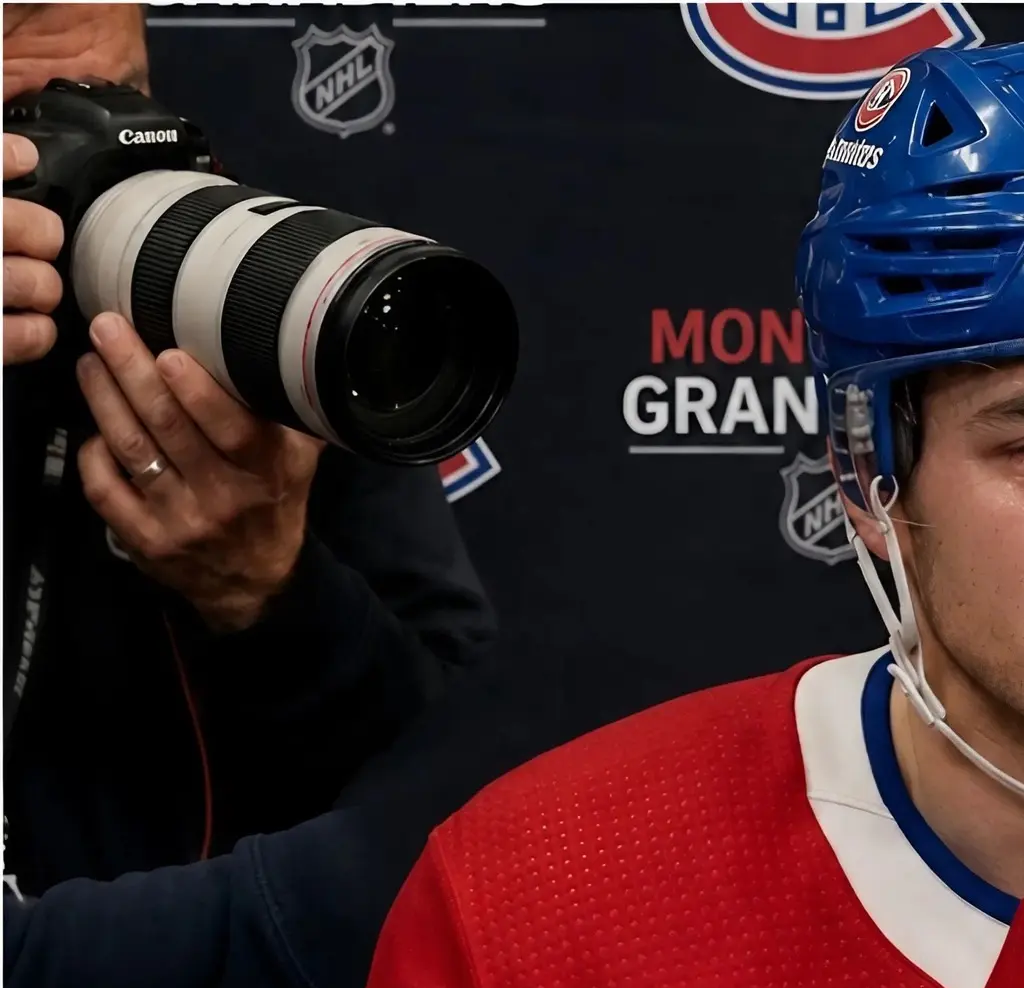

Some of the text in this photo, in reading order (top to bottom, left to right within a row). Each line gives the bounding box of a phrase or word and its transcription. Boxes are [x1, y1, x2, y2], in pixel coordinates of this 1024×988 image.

[314, 55, 373, 110] NHL
[118, 129, 178, 145] Canon
[804, 491, 844, 538] NH
